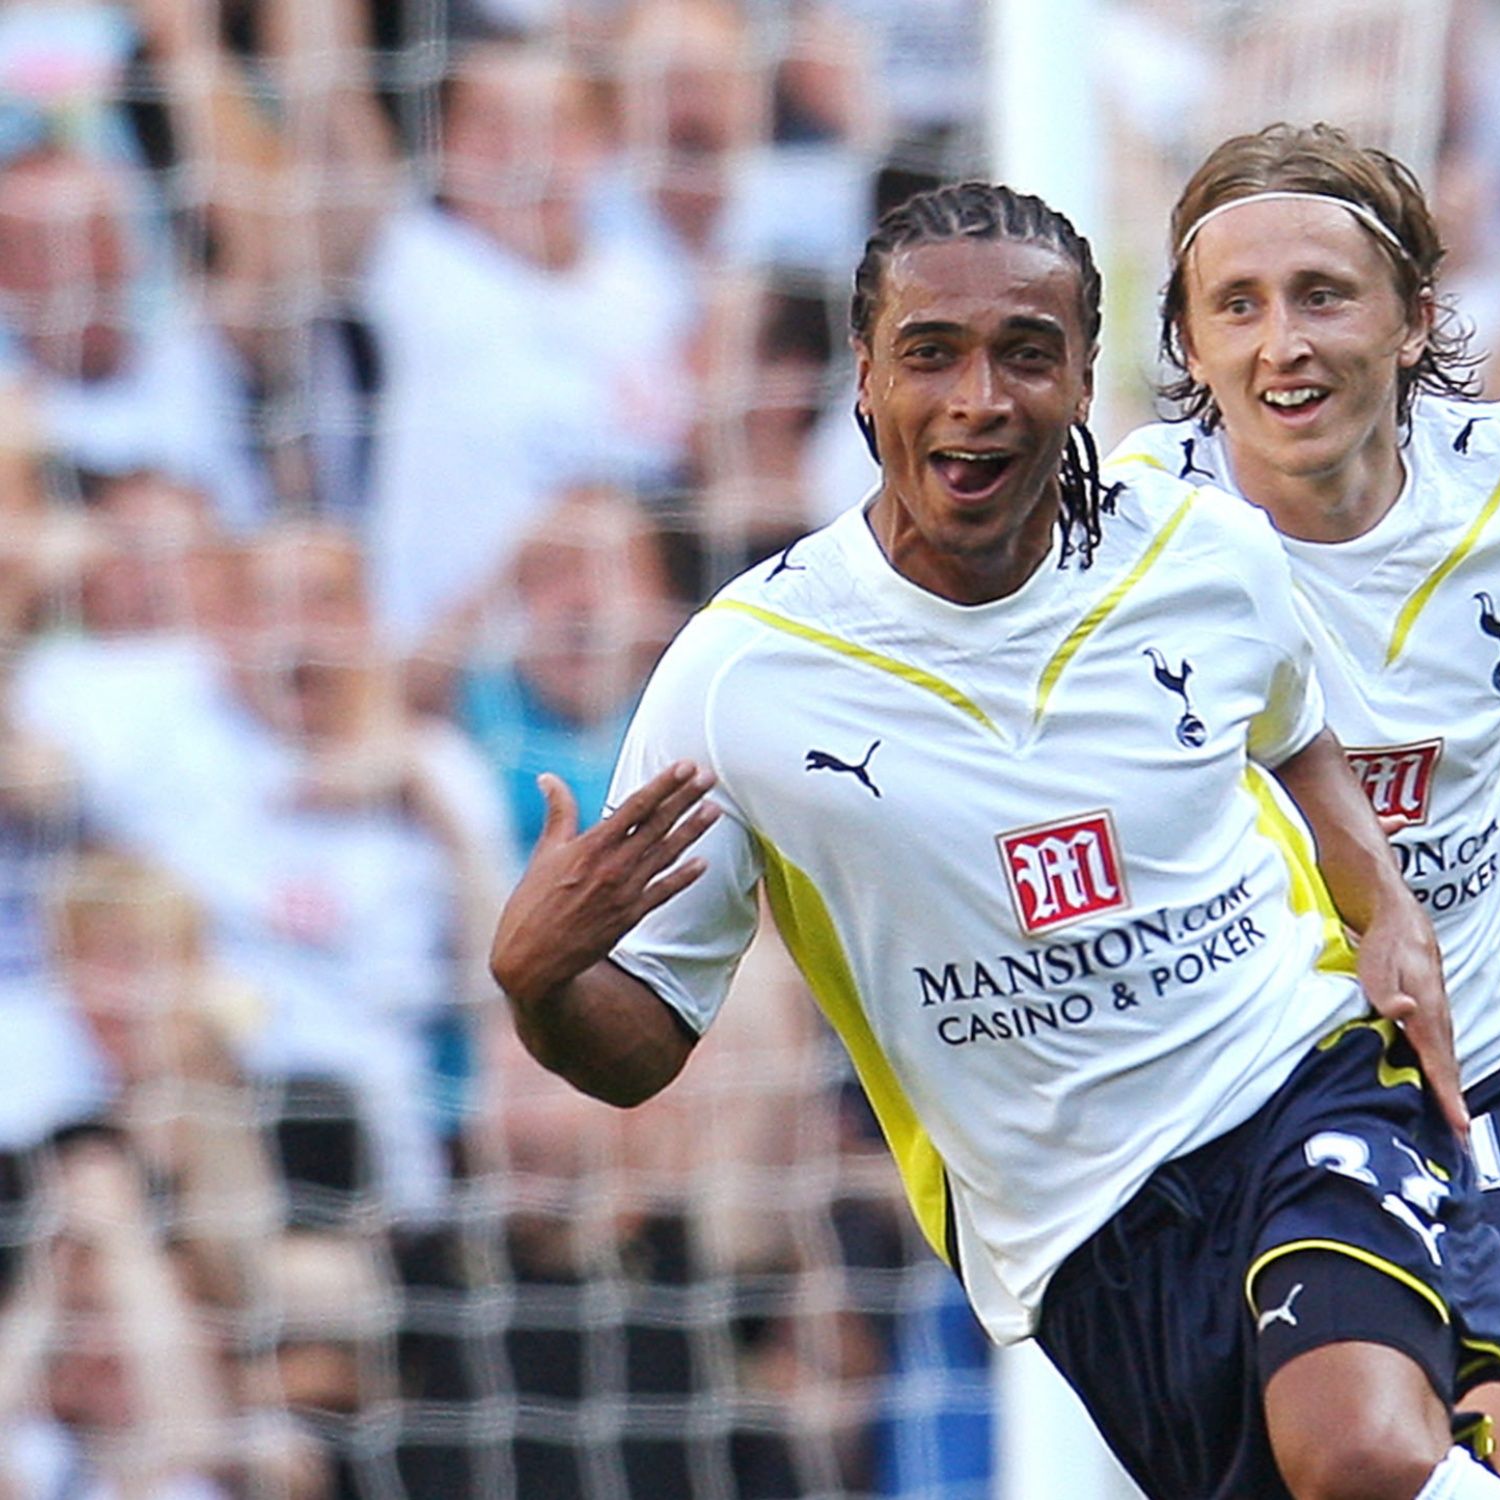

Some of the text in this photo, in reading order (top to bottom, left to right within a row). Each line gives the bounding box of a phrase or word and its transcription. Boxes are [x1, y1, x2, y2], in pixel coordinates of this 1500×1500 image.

[938, 915, 1266, 1046] CASINO & POKER
